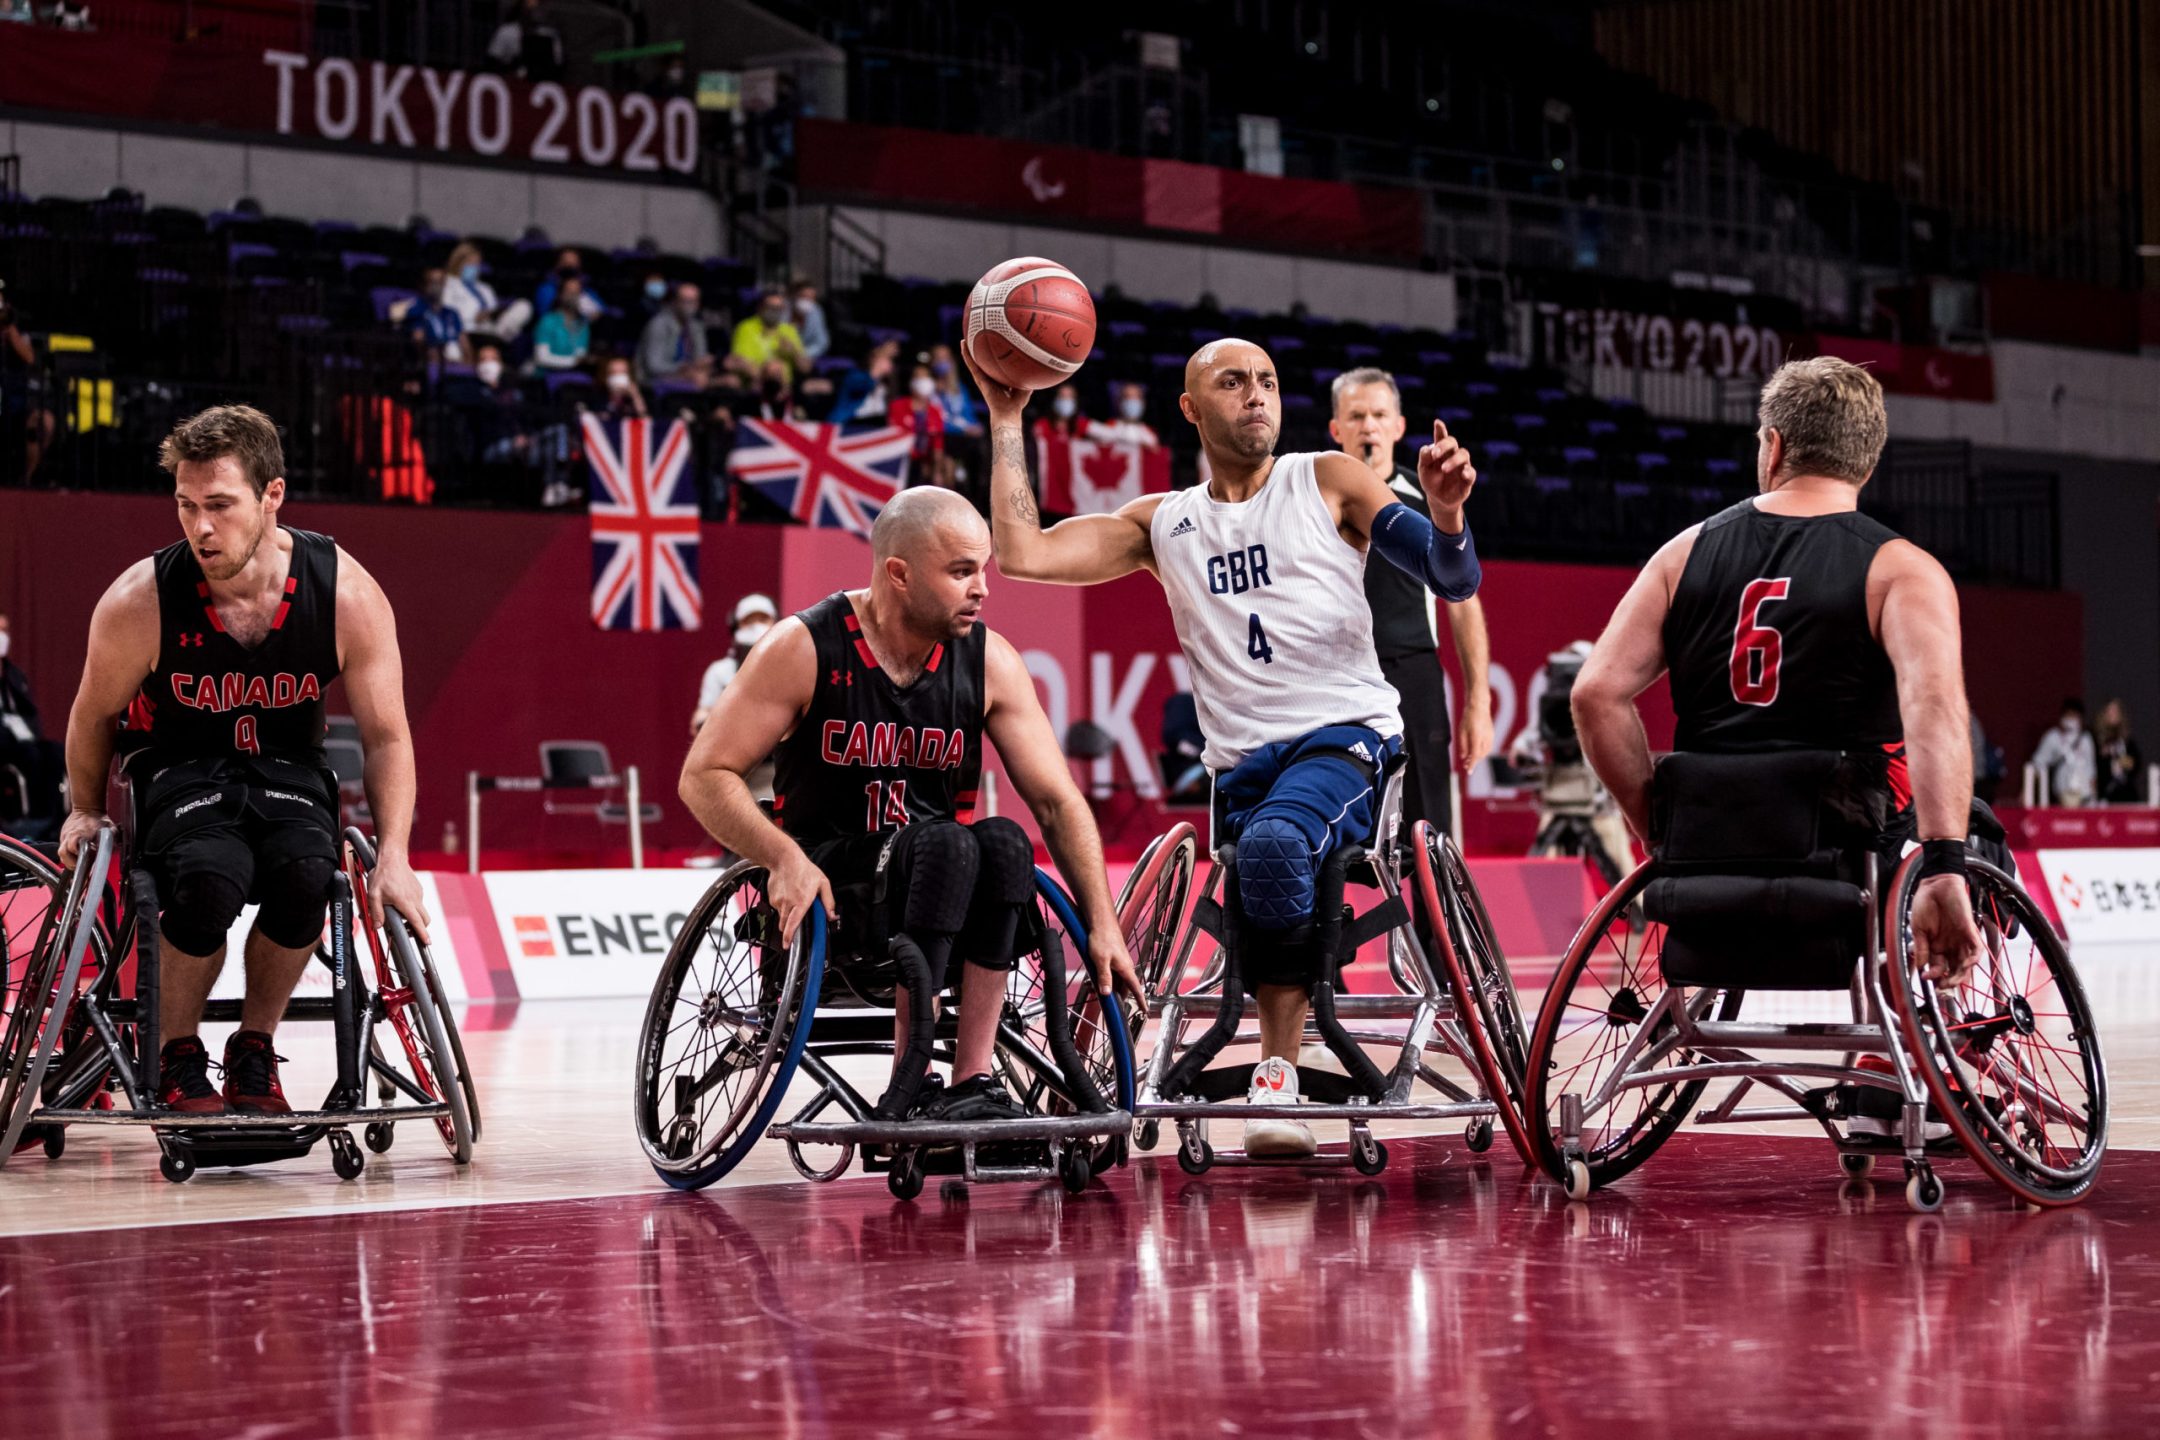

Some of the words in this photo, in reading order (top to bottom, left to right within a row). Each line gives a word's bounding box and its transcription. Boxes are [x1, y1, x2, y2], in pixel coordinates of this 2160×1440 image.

[263, 48, 512, 157] TOKYO
[529, 80, 699, 174] 2020
[1536, 301, 1675, 369] TOKYO
[1681, 318, 1782, 379] 2020
[1169, 526, 1197, 538] adidas
[1207, 543, 1272, 595] GBR
[1248, 612, 1273, 664] 4
[1729, 577, 1791, 707] 6
[171, 672, 320, 713] CANADA
[235, 714, 261, 756] 9
[821, 719, 964, 771] CANADA
[865, 779, 910, 832] 14
[2090, 879, 2160, 912] 日本生
